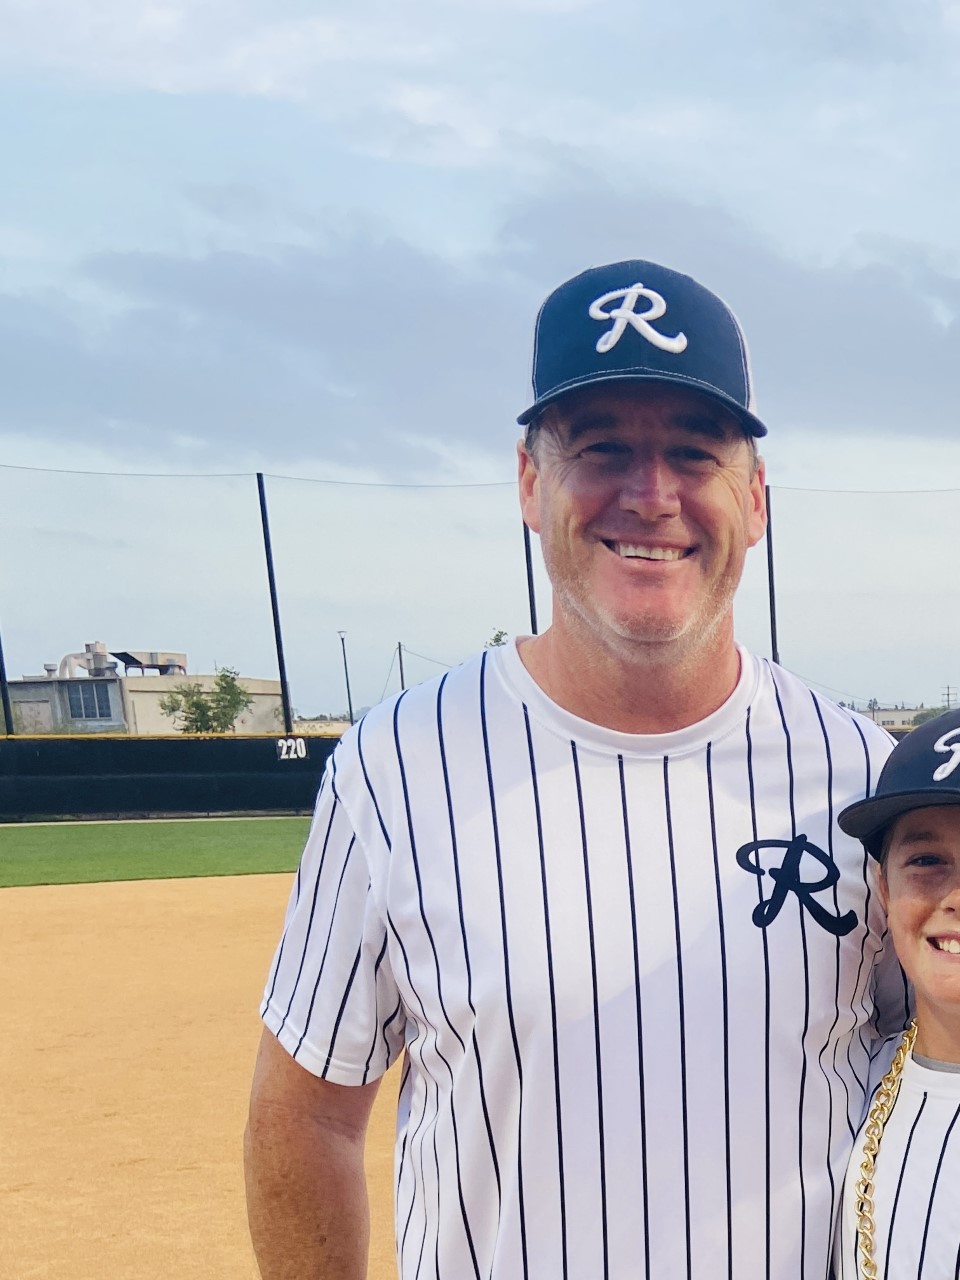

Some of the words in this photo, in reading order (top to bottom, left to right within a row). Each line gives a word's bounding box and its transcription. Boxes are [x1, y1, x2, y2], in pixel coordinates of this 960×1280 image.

[589, 282, 688, 354] R
[277, 738, 307, 759] 220
[736, 834, 859, 937] R
